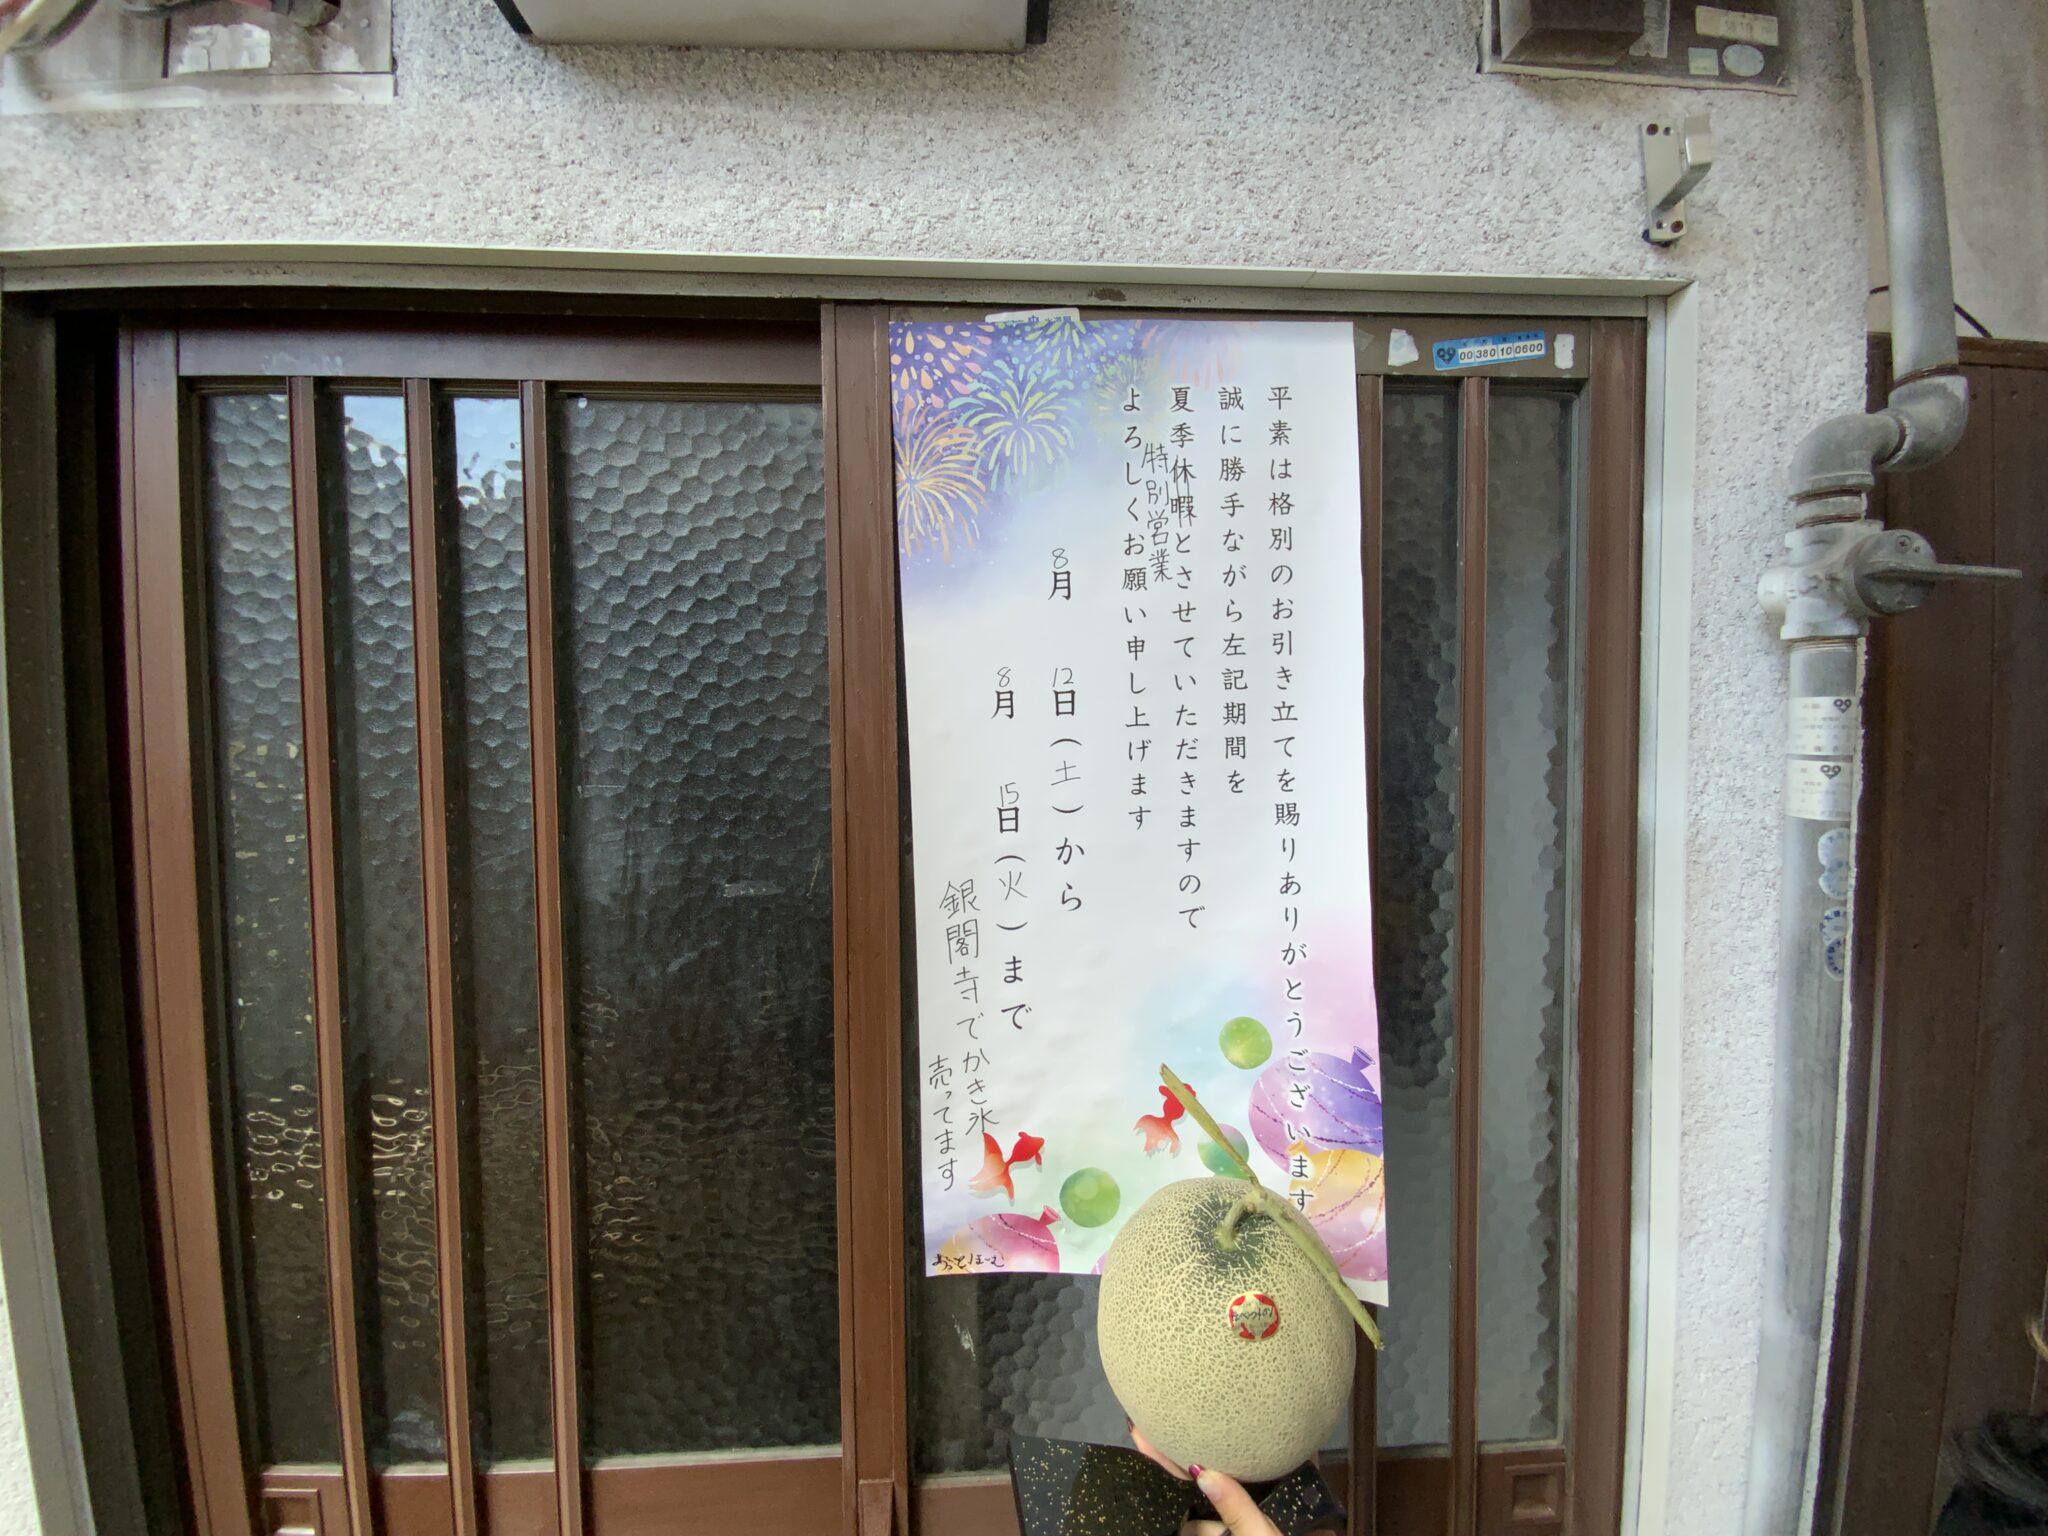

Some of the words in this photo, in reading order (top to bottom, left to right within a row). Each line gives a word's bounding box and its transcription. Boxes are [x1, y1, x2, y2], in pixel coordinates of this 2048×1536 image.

[1047, 547, 1073, 601] 8月
[1121, 387, 1153, 829] よろしくお願い申し上げます
[1141, 442, 1173, 583] 特別営業
[1218, 386, 1248, 793] 誠に勝手ながら左記期間を
[990, 666, 1015, 720] 8月
[1169, 386, 1206, 928] 夏季休暇とさせていただきますので
[1266, 385, 1314, 1212] 平素は格別のお引き立てを賜りありがとうございます
[928, 1054, 959, 1192] 売ってます
[939, 879, 1000, 1136] 銀閣寺でかき氷
